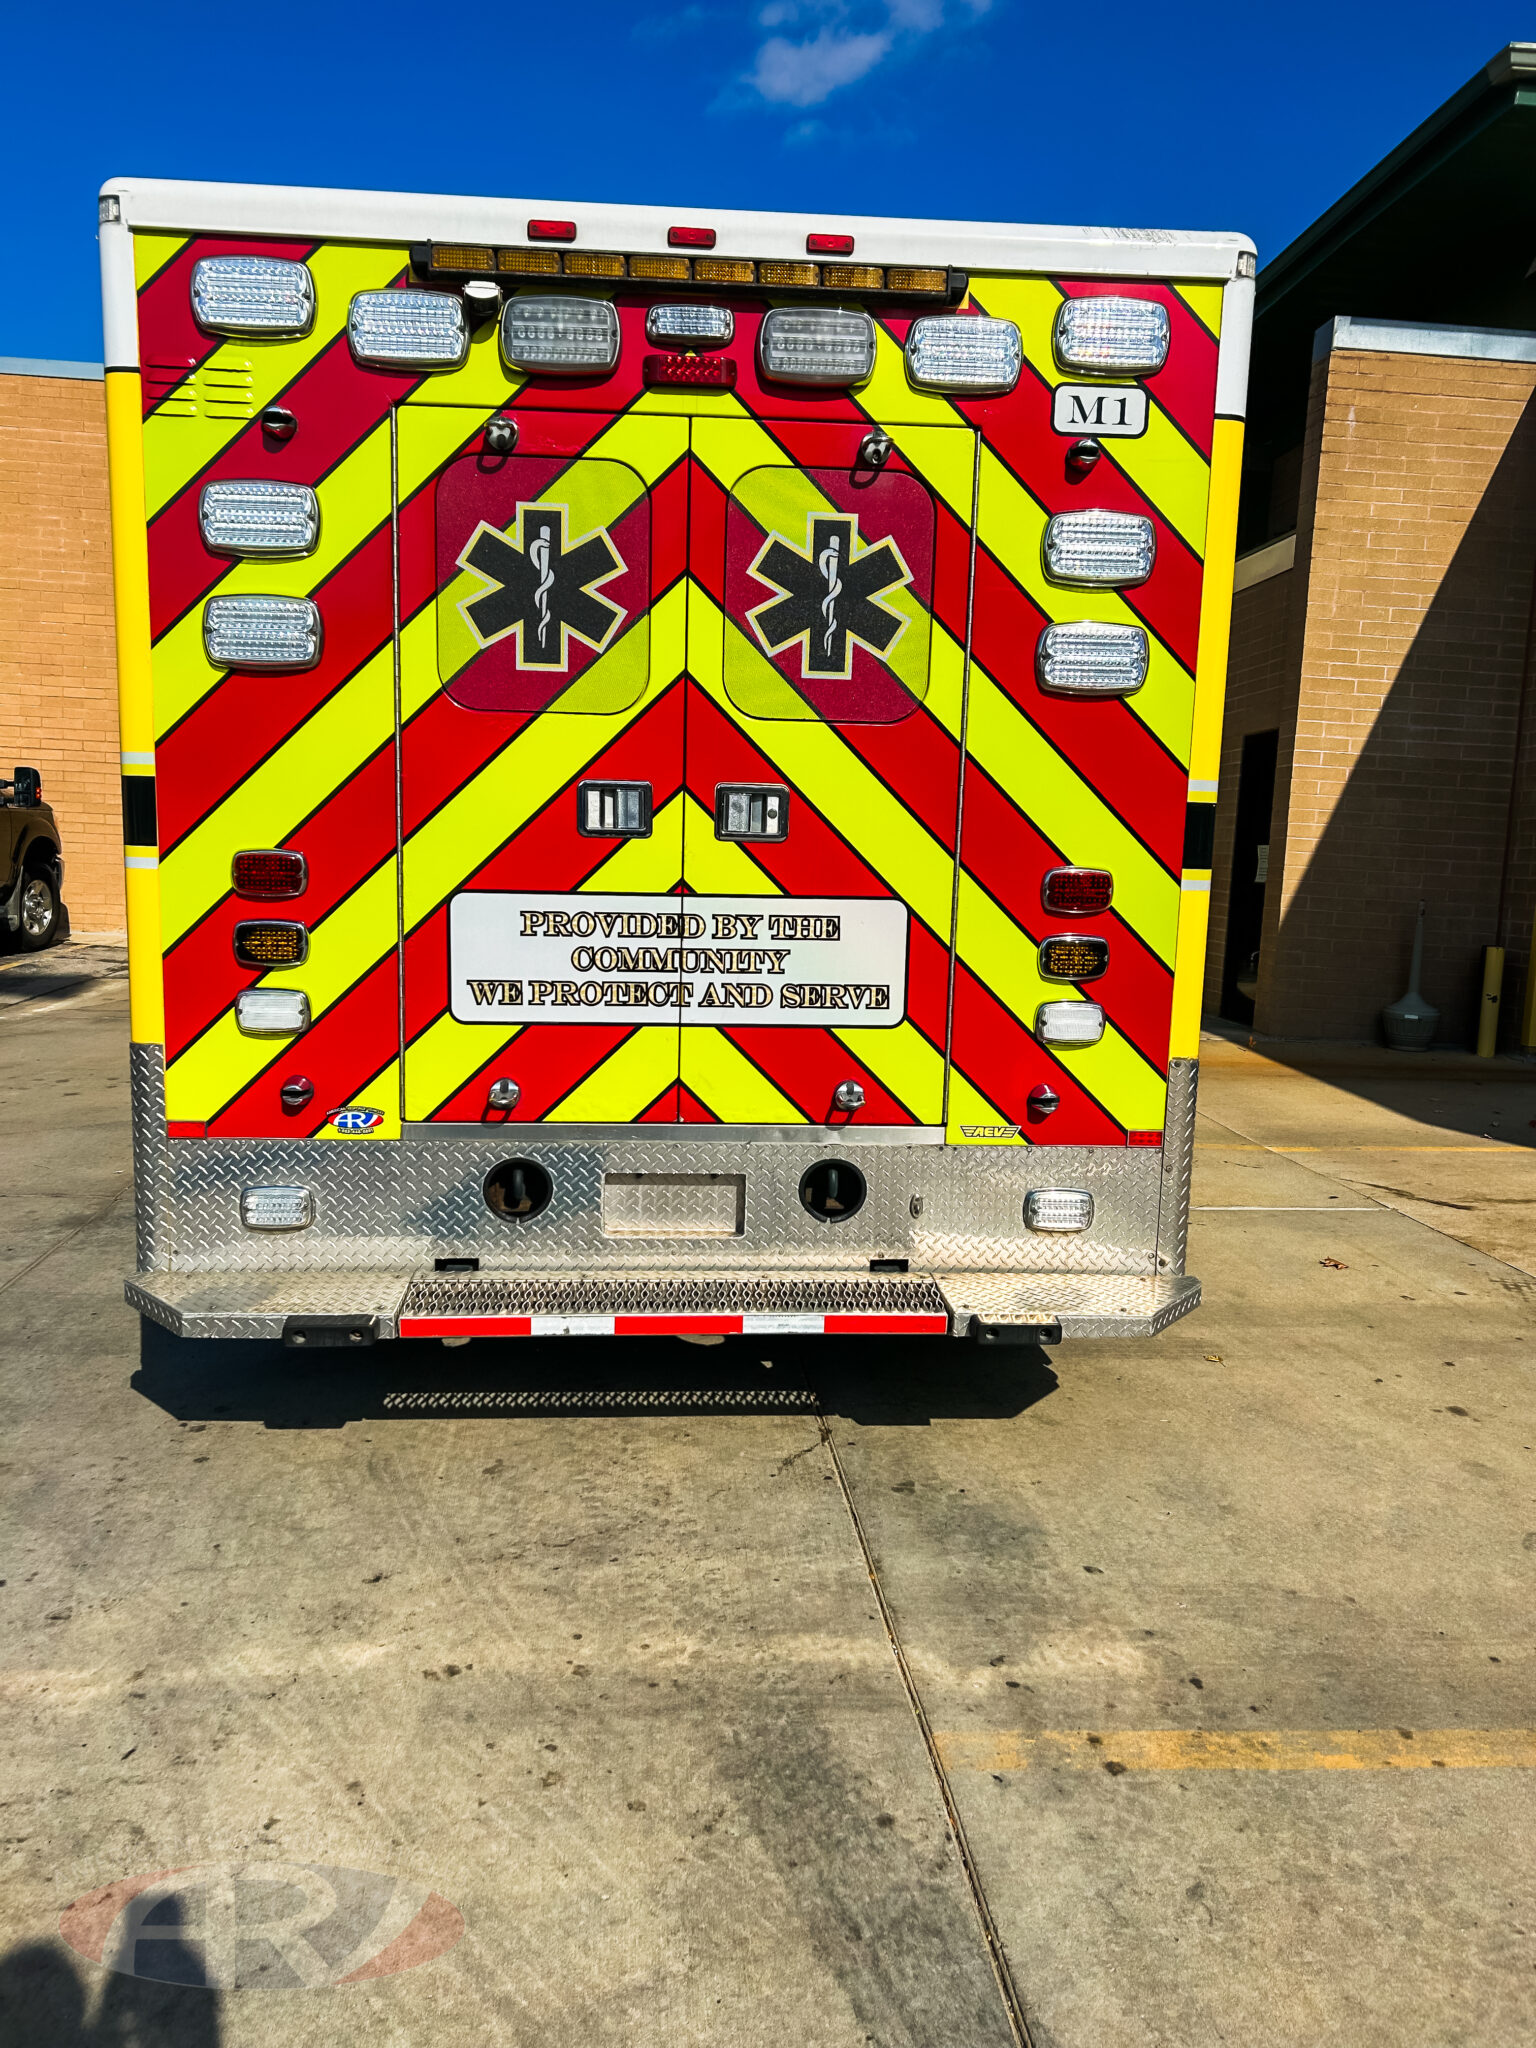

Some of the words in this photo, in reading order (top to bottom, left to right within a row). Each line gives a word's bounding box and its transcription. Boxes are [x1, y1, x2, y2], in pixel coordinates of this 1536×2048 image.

[1067, 395, 1132, 426] M1
[520, 911, 706, 940] PROVIDED
[711, 914, 763, 940] BY
[768, 915, 840, 941] THE
[571, 946, 791, 974] COMMUNITY
[467, 980, 523, 1006] WE
[528, 980, 694, 1008] PROTECT
[698, 982, 774, 1008] AND
[779, 983, 890, 1010] SERVE
